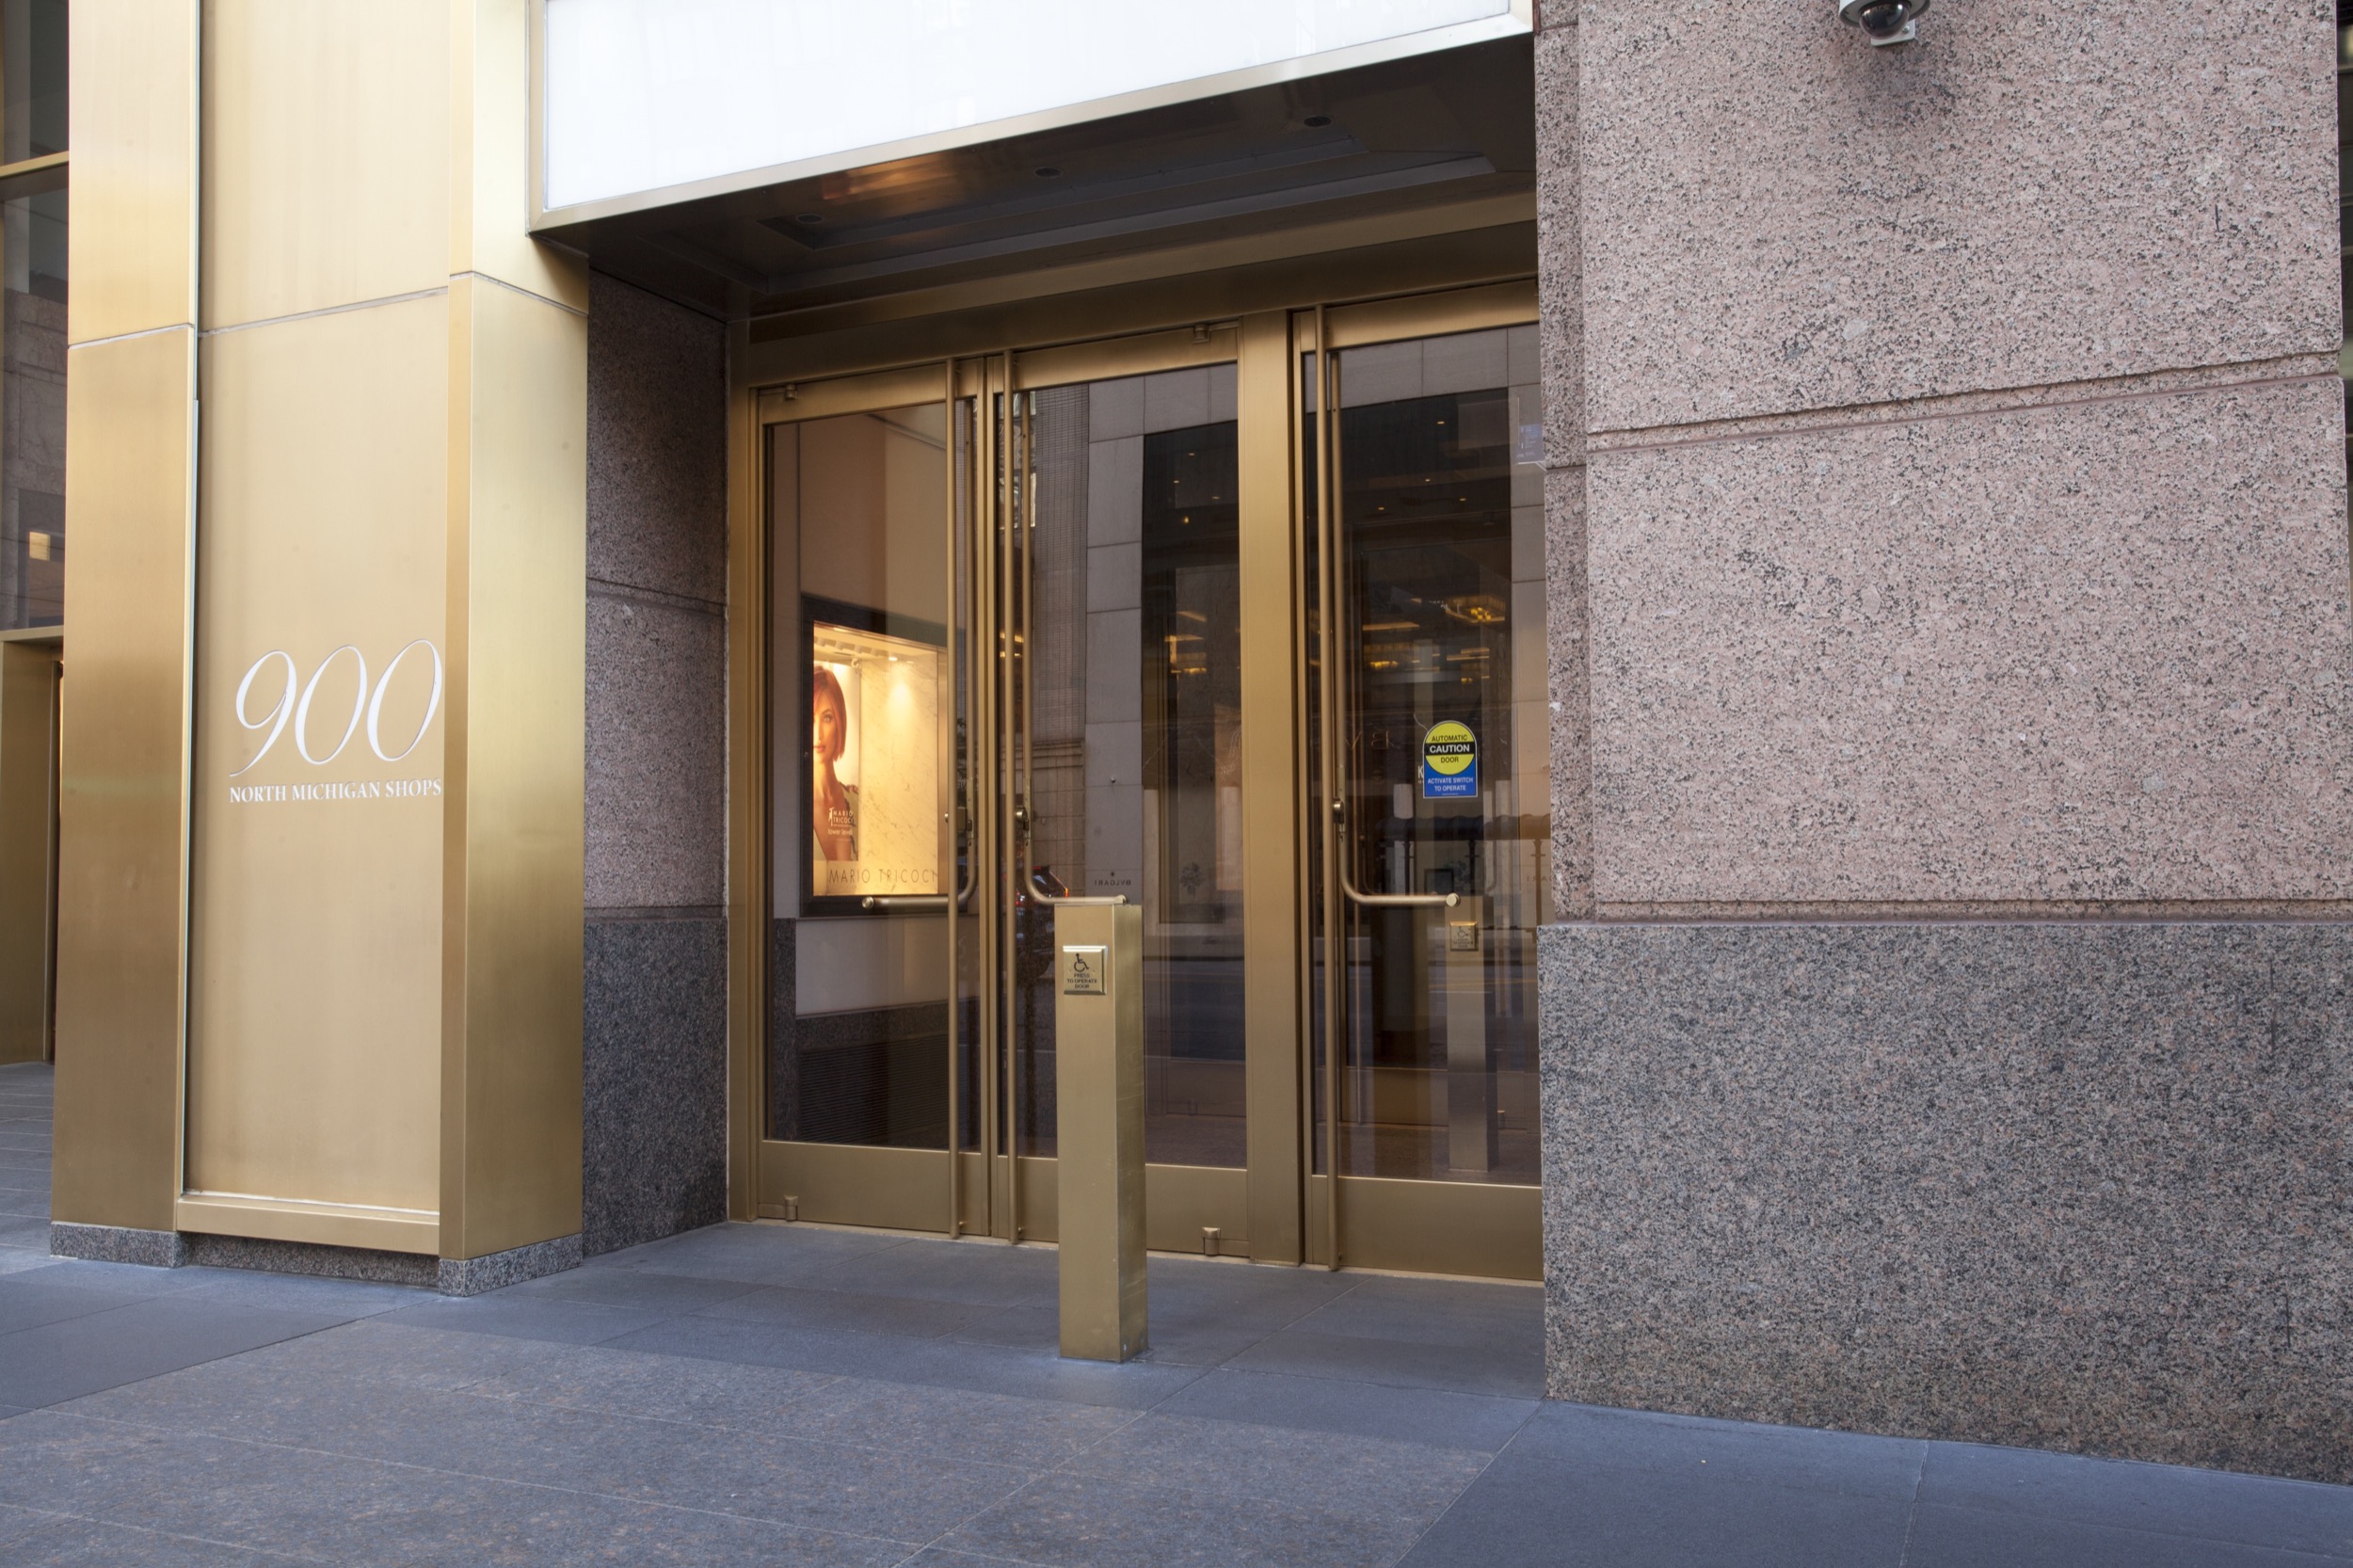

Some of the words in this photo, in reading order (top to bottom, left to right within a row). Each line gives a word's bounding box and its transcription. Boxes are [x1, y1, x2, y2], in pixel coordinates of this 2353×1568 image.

[230, 638, 442, 777] 900
[1430, 744, 1470, 753] CAUTION
[230, 785, 286, 803] NORTH
[292, 781, 380, 800] MICHIGAN
[385, 778, 441, 797] SHOPS
[828, 869, 871, 884] MARIO
[878, 869, 936, 883] TRICOCI
